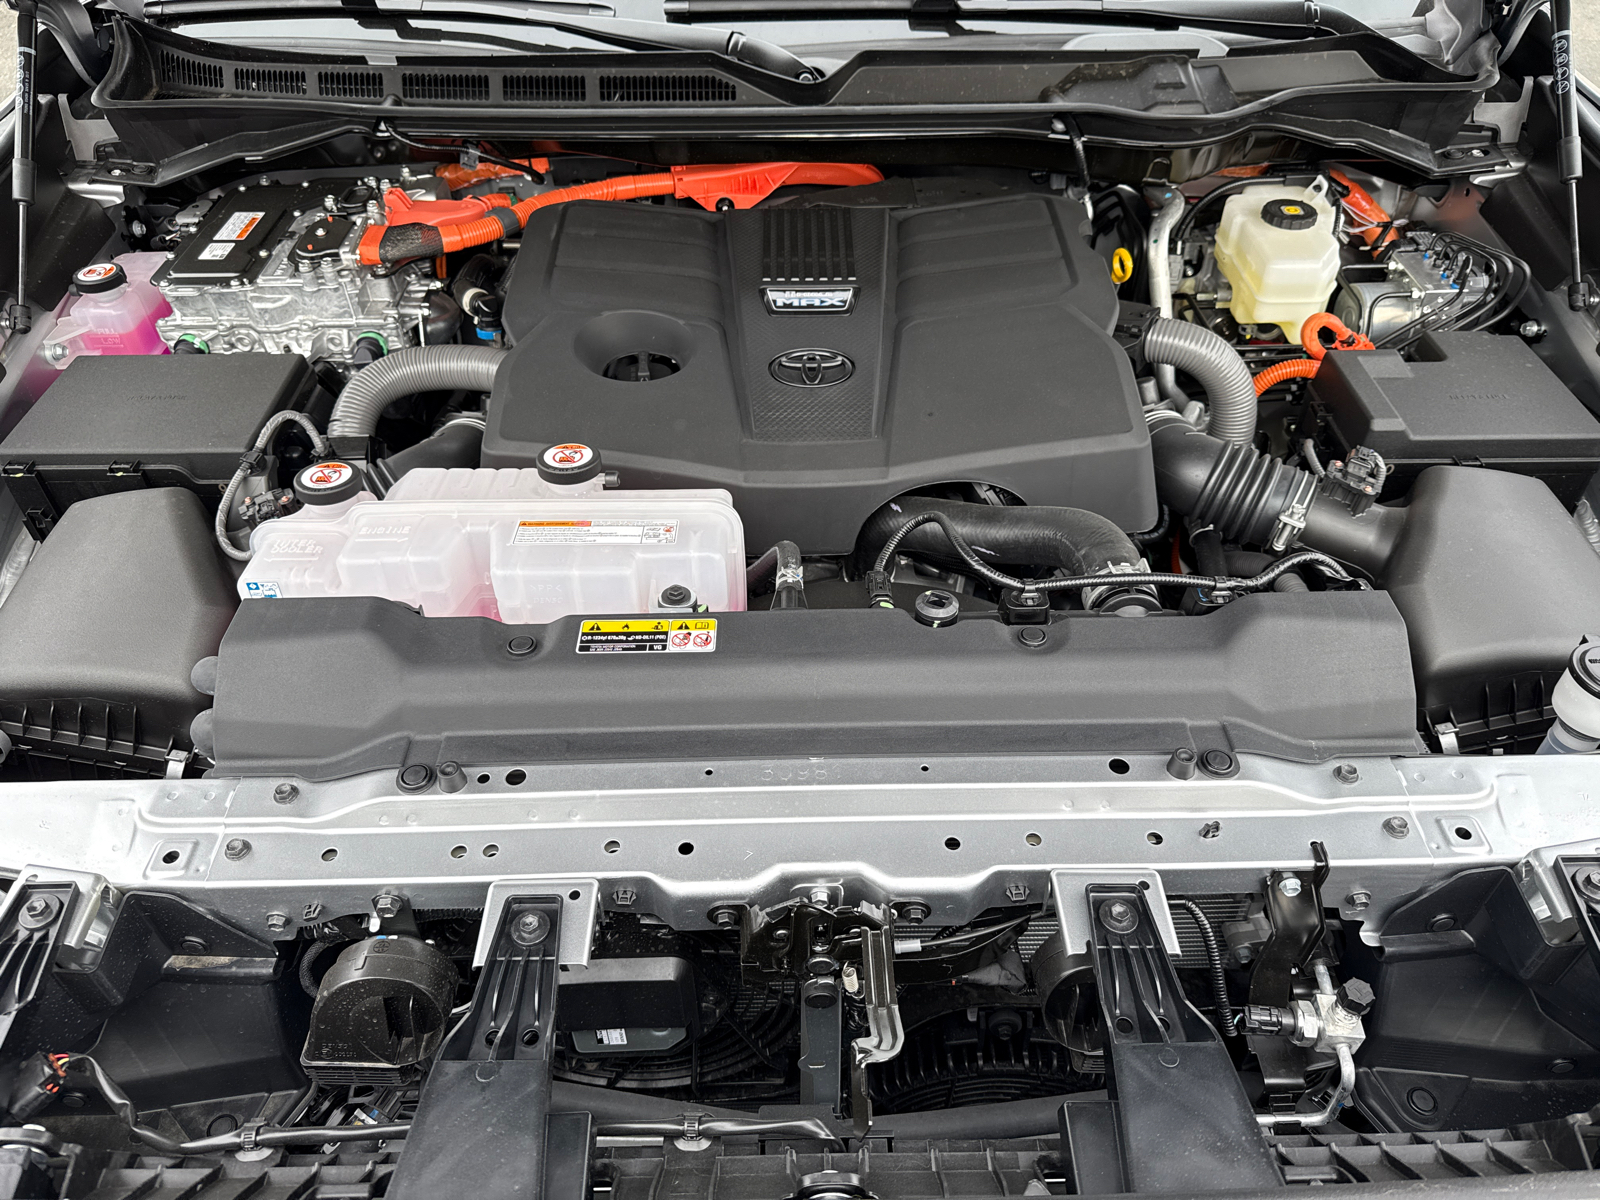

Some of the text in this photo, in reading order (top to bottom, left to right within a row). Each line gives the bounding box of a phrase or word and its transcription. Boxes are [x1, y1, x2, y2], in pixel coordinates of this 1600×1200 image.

[775, 297, 845, 307] MAX
[358, 525, 412, 535] ENGINE
[532, 596, 564, 604] DENSO
